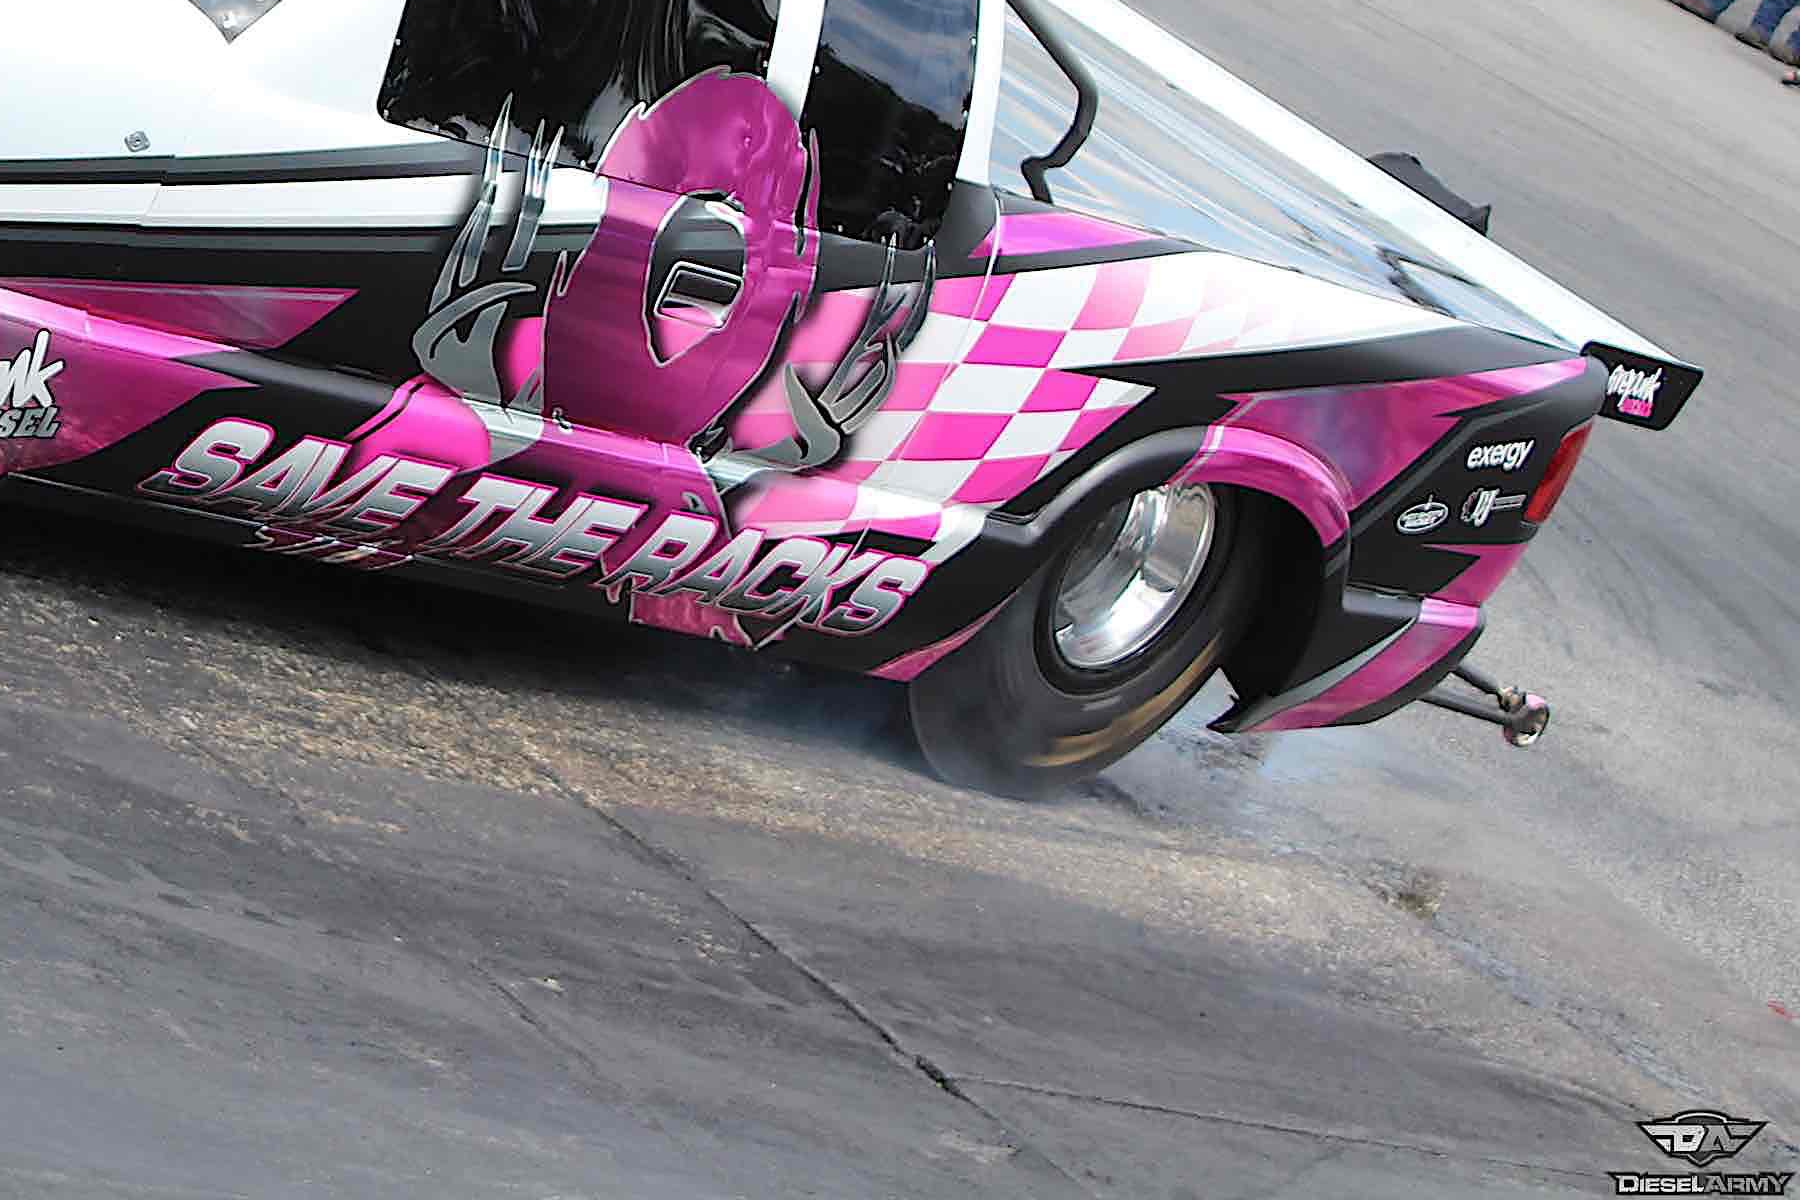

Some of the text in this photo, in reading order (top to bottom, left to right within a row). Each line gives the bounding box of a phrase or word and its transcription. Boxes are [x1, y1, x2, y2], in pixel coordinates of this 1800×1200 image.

[1465, 439, 1535, 471] exergy
[137, 416, 929, 637] SAVE THE RACKS
